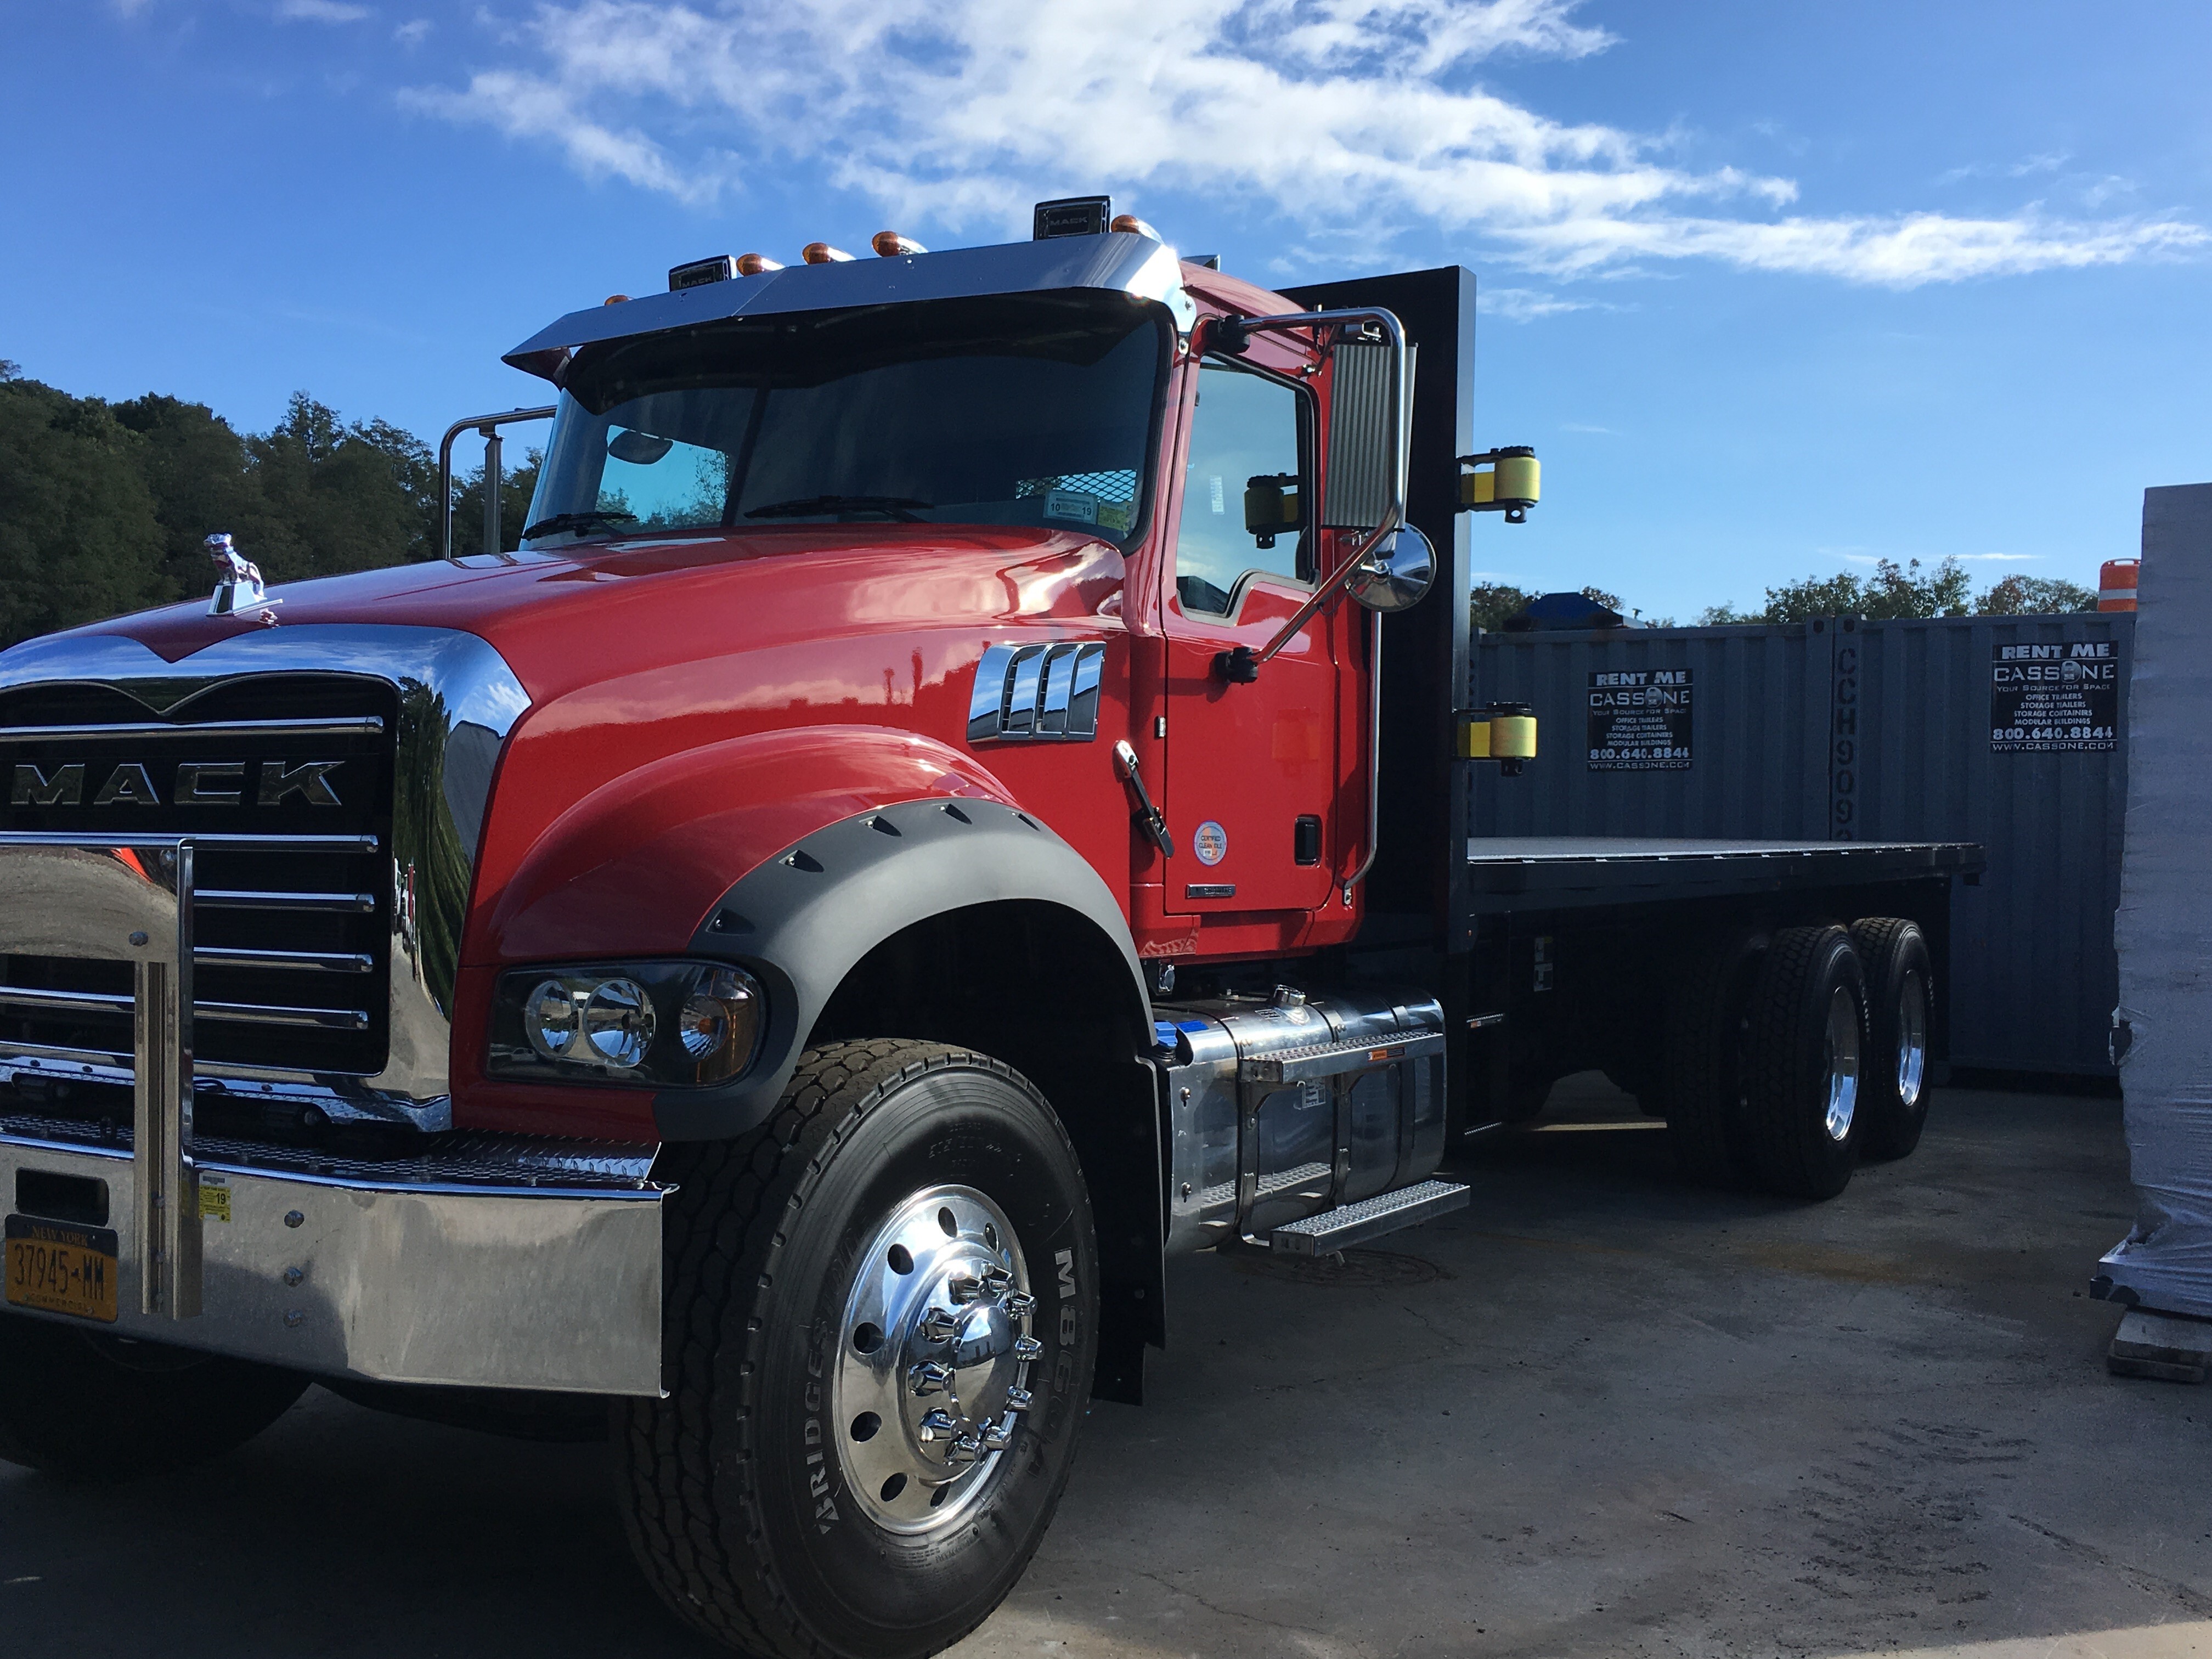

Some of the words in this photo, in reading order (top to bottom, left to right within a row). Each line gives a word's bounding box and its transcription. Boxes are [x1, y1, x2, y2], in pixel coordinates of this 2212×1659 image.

[1051, 217, 1088, 225] MACK
[682, 276, 712, 287] MACK
[1082, 507, 1092, 515] 19
[2002, 645, 2063, 659] RENT
[2070, 643, 2110, 657] ME
[1596, 673, 1647, 686] RENT
[1654, 671, 1686, 684] ME
[1994, 661, 2114, 684] CASSONE
[1590, 687, 1690, 708] CASSONE
[1993, 726, 2113, 740] 800.640.8844
[1590, 747, 1689, 759] 800.640.8844
[11, 761, 345, 806] MACK
[217, 1192, 226, 1204] 19
[32, 1226, 57, 1241] NEW
[59, 1230, 88, 1247] YORK
[15, 1243, 69, 1294] 37945
